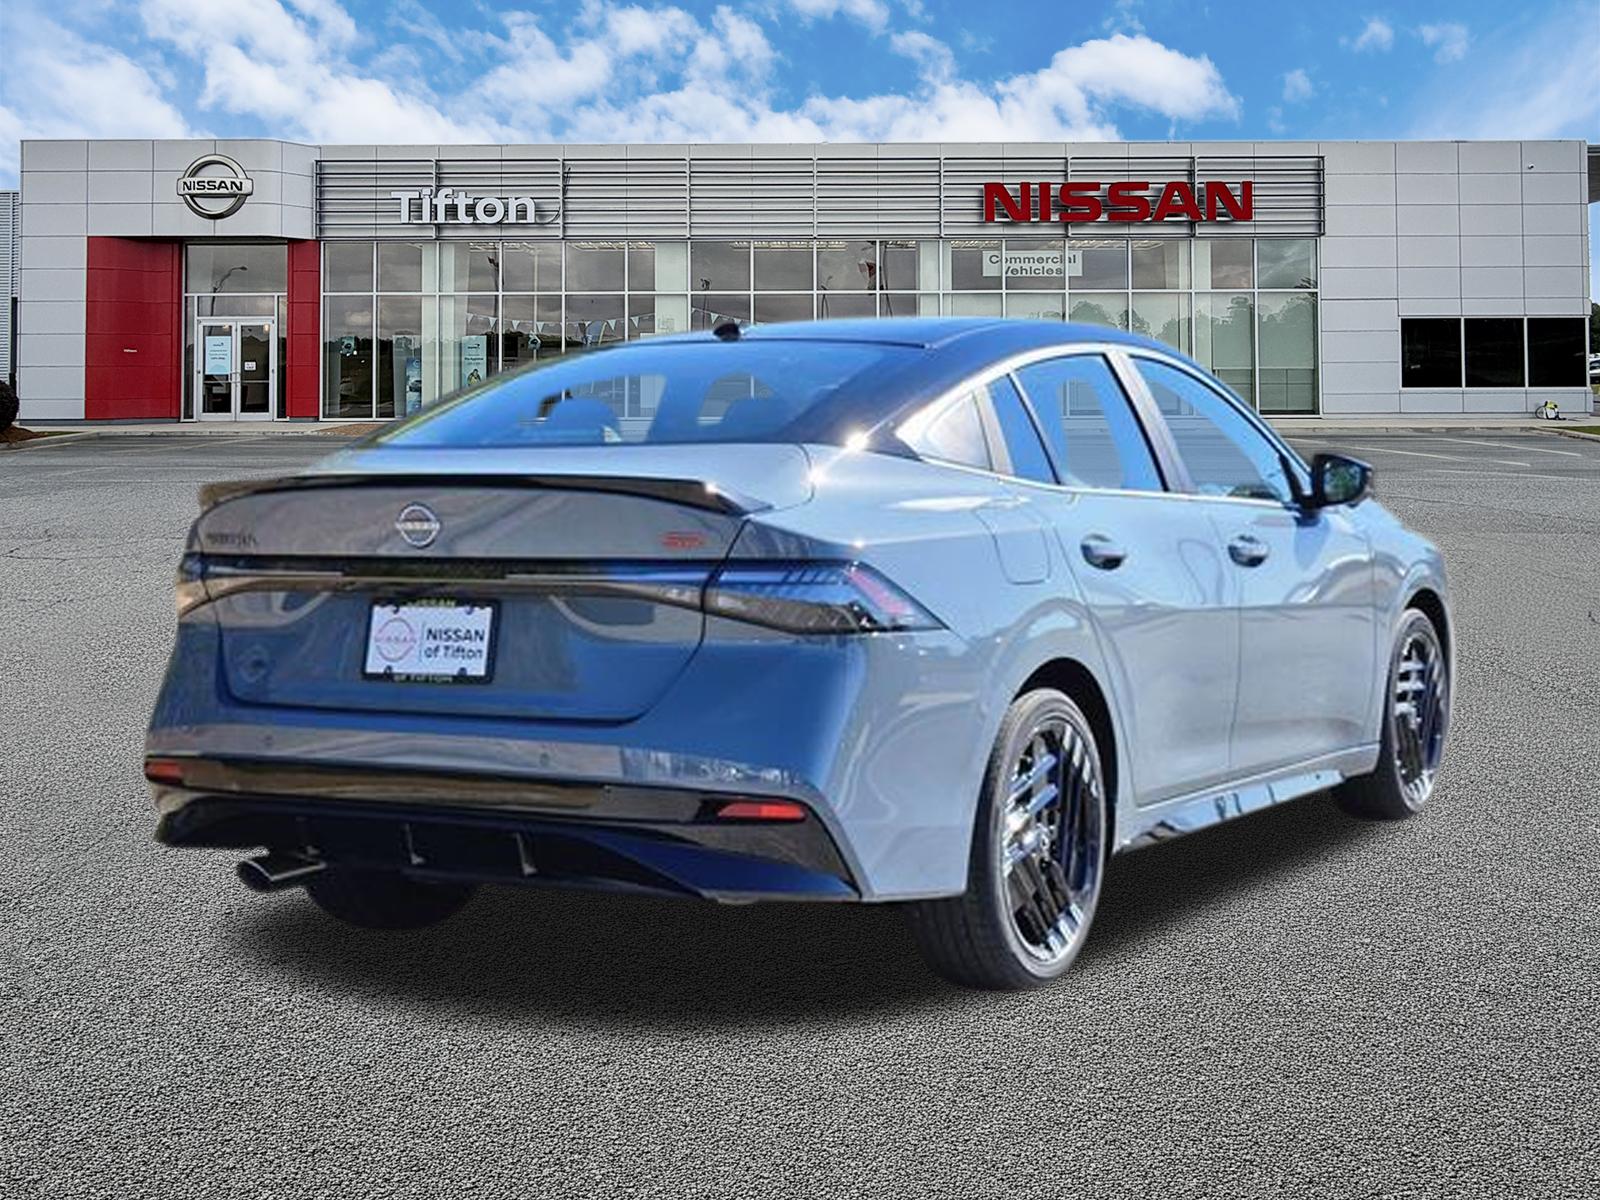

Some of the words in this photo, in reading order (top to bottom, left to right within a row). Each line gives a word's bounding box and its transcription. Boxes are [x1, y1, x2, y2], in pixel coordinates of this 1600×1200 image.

[182, 180, 243, 191] NISSAN
[391, 187, 536, 224] Tifton
[983, 180, 1253, 222] NISSAN
[426, 628, 485, 642] NISSAN
[425, 645, 440, 659] of
[443, 645, 483, 660] Tifton
